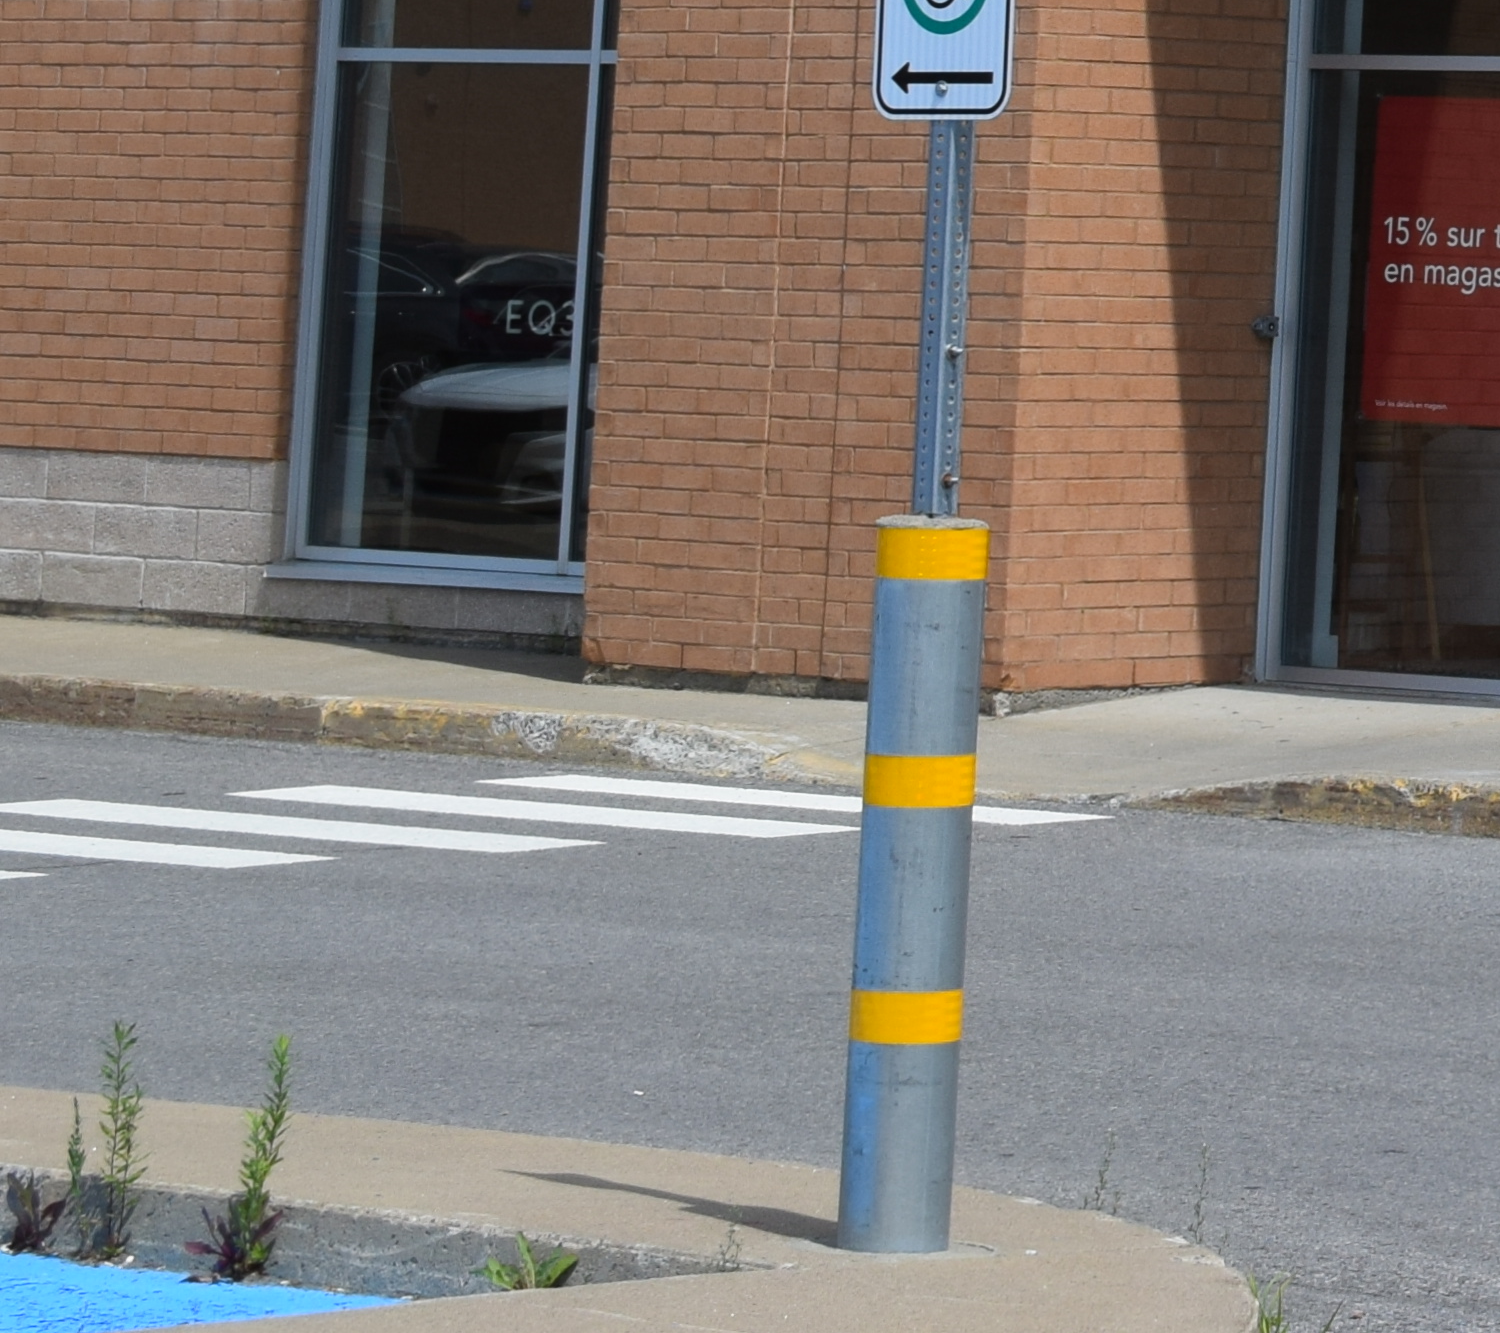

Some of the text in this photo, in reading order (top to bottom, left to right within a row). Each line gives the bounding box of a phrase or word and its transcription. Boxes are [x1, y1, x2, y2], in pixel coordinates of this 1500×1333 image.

[1447, 226, 1485, 247] sur
[1384, 262, 1414, 283] en
[506, 300, 574, 336] EQ3
